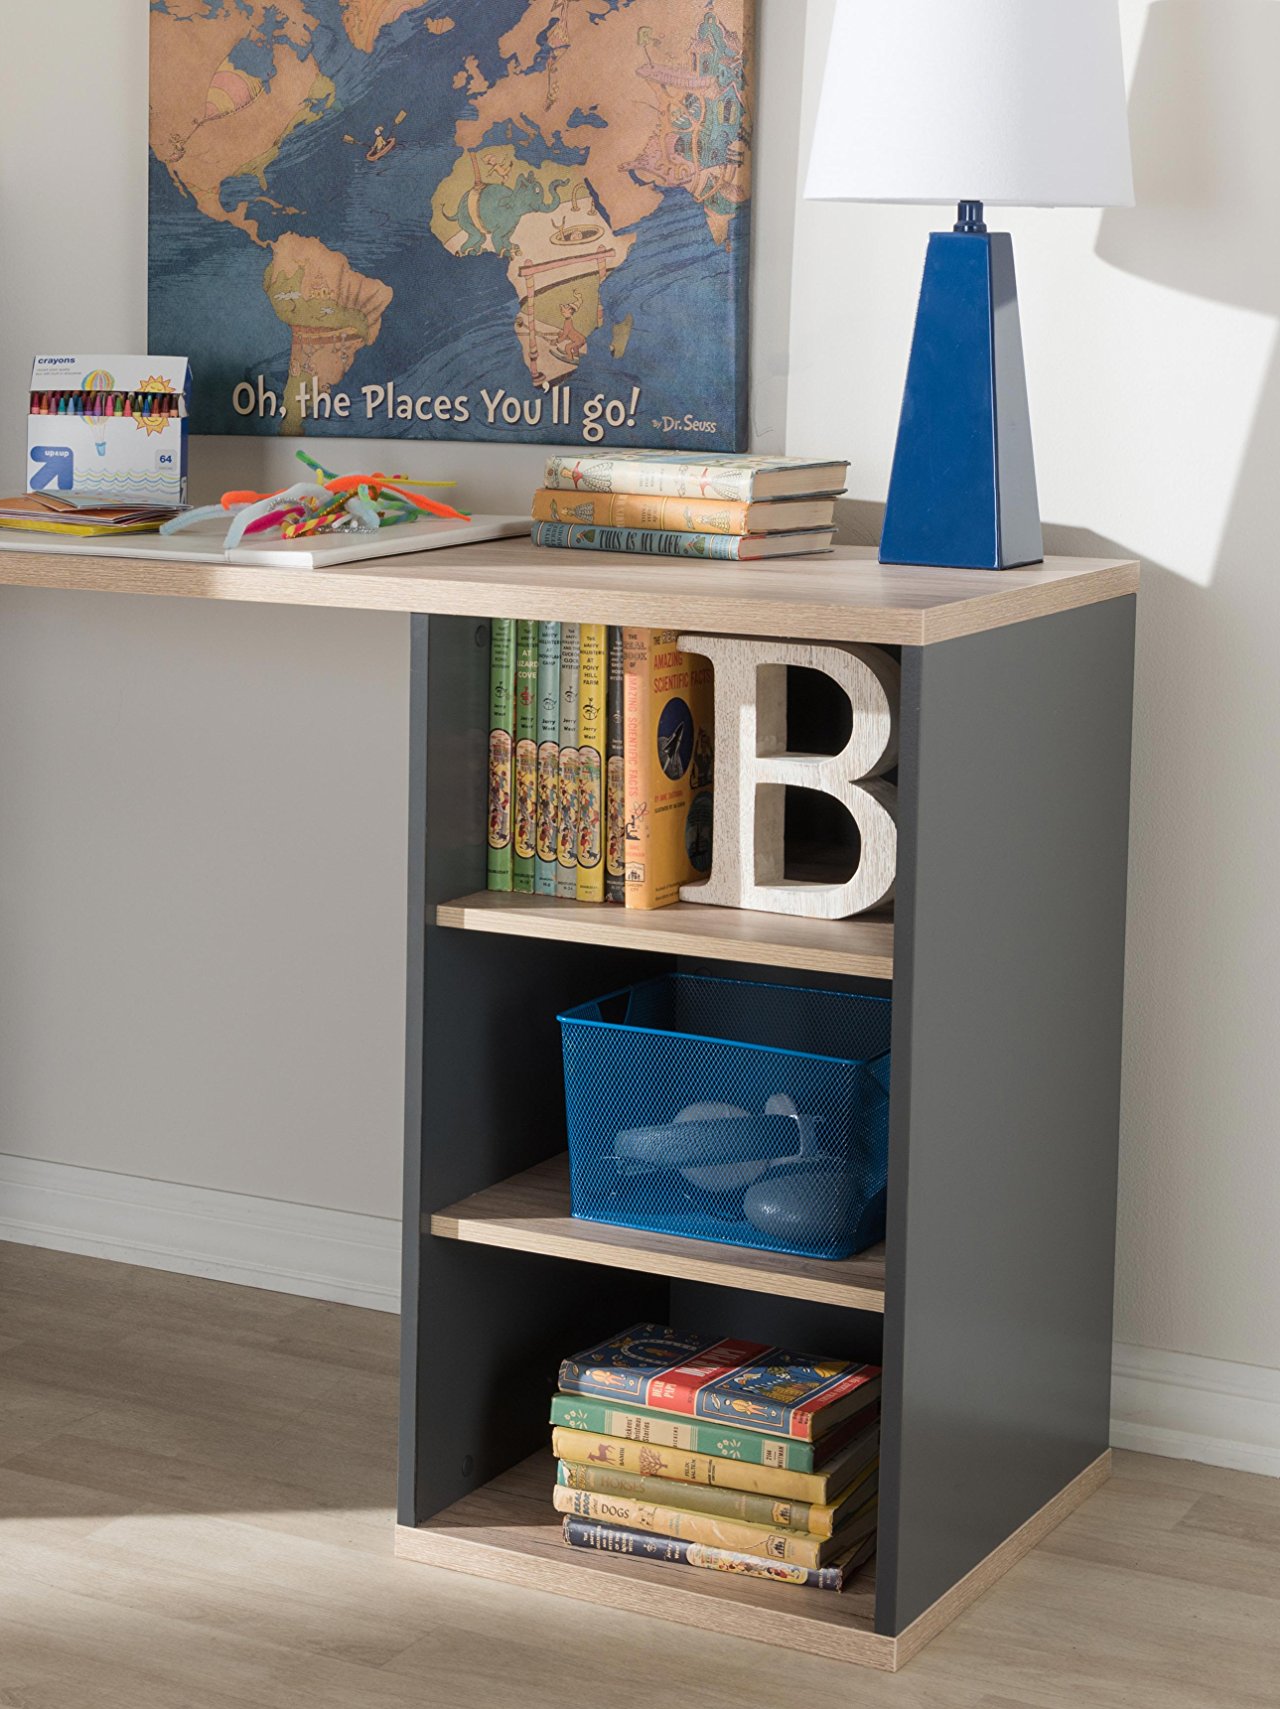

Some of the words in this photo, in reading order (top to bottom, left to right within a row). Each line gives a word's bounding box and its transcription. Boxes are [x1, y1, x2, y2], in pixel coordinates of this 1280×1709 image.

[38, 357, 75, 365] crayons
[232, 374, 287, 419] Oh,
[295, 376, 351, 419] the
[361, 382, 469, 421] Places
[480, 381, 570, 425] You'll
[582, 386, 641, 442] go!
[662, 416, 682, 432] Dr.
[683, 414, 717, 434] Seuss
[159, 454, 172, 464] 64
[599, 529, 622, 550] THIS
[625, 531, 637, 551] IS
[640, 532, 656, 552] MY
[657, 533, 682, 554] LIFE
[653, 651, 683, 671] AMAZING
[628, 671, 638, 712] AMAZING
[653, 671, 689, 693] SCIENTIFIC
[628, 717, 638, 765] SCIENTIFIC
[628, 769, 638, 797] FACTS
[676, 634, 897, 920] B
[642, 1421, 650, 1442] Stories
[601, 1474, 646, 1493] HORSES
[574, 1491, 582, 1514] REAL
[582, 1492, 591, 1516] BOOK
[601, 1503, 630, 1519] DOGS
